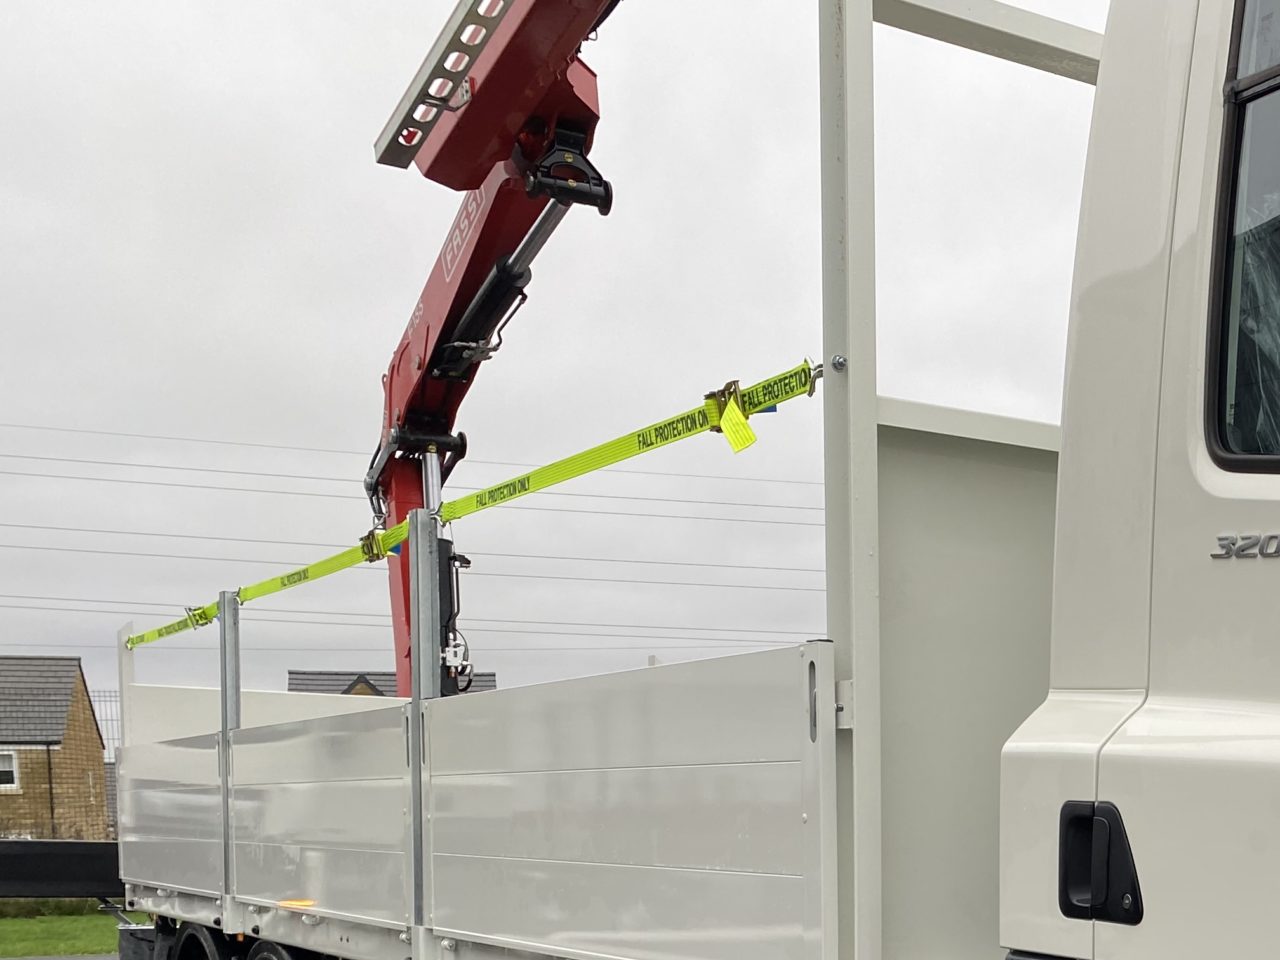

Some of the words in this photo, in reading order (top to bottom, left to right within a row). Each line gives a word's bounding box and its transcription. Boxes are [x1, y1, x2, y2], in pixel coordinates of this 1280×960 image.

[741, 385, 762, 413] FALL
[637, 429, 654, 450] FALL
[655, 412, 697, 444] PROTECTION
[475, 491, 487, 508] FALL
[487, 481, 516, 505] PROTECTION
